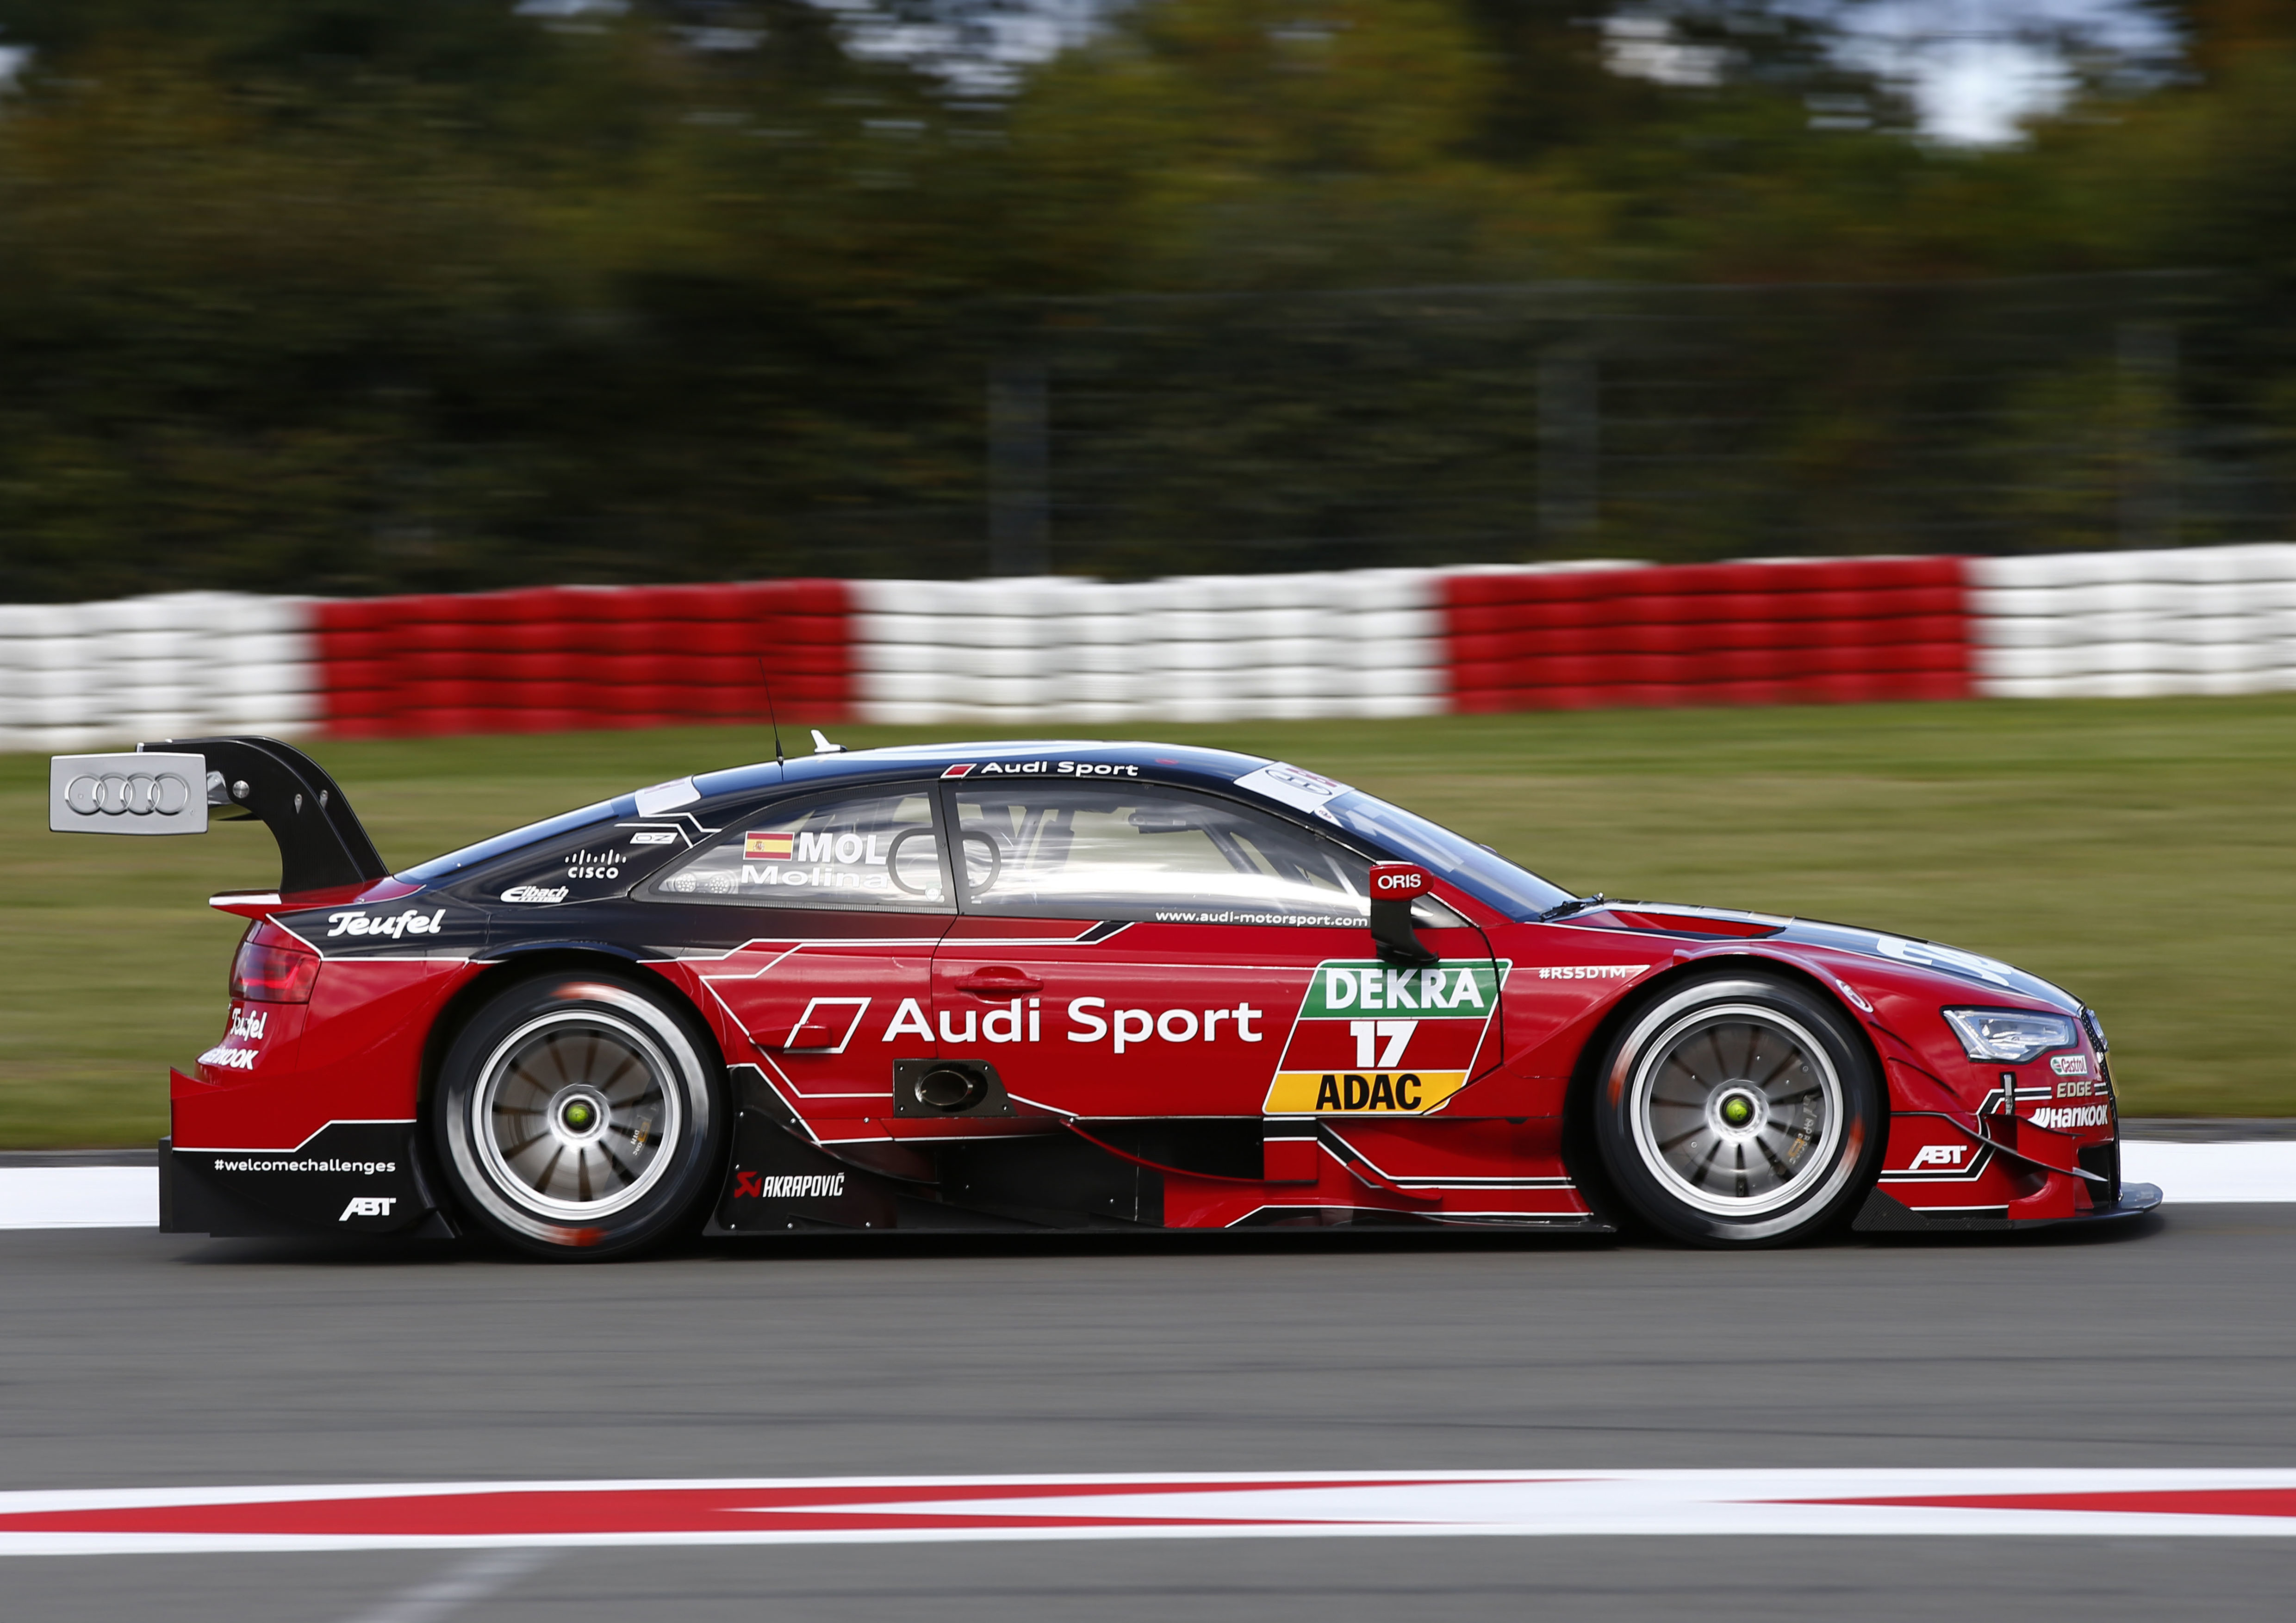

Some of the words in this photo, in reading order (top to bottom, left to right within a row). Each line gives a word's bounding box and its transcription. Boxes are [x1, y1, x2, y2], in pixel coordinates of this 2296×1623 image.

[980, 761, 1047, 774] Audi
[1057, 761, 1139, 777] Sport
[797, 832, 887, 865] MOL
[740, 864, 888, 889] Molina
[1377, 873, 1422, 889] ORIS
[500, 885, 569, 903] Eibach
[327, 908, 447, 939] Teufel
[1155, 910, 1368, 927] www.audi-motorsport.com
[1538, 966, 1626, 979] #RS5DTM
[1325, 968, 1485, 1010] DEKRA
[881, 997, 1041, 1044] Audi
[1067, 996, 1263, 1054] Sport
[1350, 1020, 1419, 1068] 17
[2060, 1057, 2087, 1074] Castrol
[1315, 1073, 1422, 1111] ADAC
[2056, 1081, 2093, 1098] EDGE
[214, 1158, 396, 1175] #welcomechallenges
[1908, 1145, 1967, 1170] ABT
[338, 1197, 397, 1222] ABT
